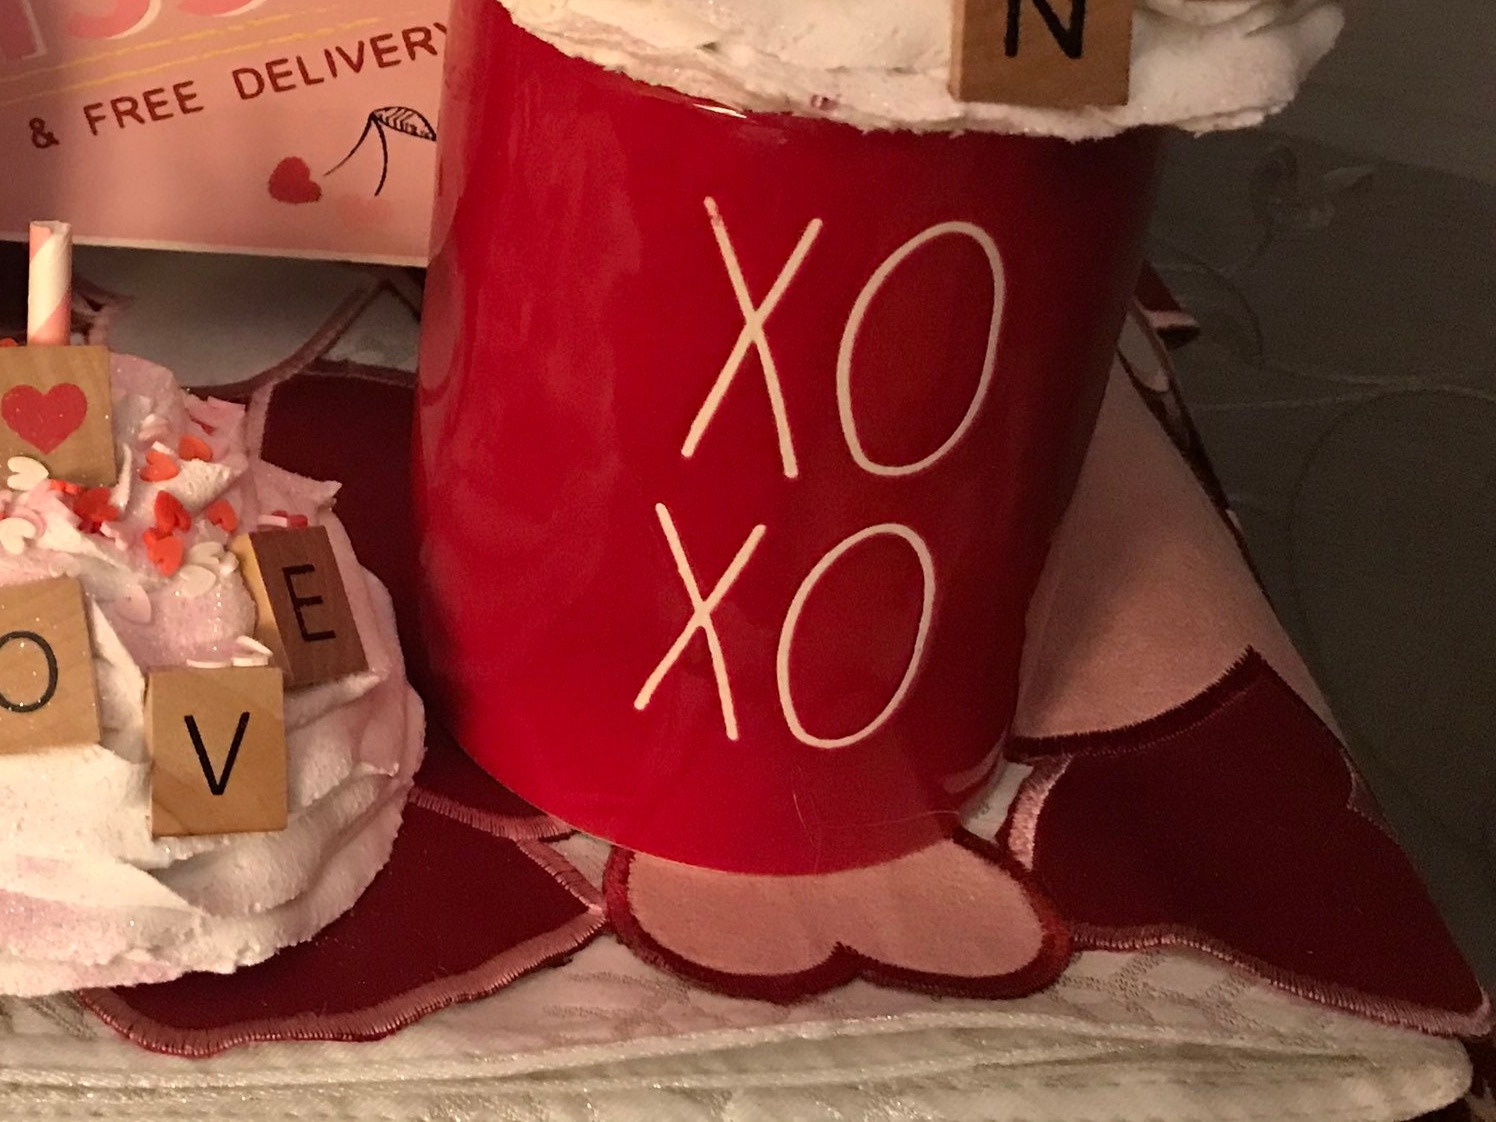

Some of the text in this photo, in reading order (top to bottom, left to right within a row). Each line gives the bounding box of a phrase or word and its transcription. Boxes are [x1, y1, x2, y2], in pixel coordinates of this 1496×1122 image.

[28, 117, 60, 150] &
[83, 81, 205, 137] FREE
[232, 22, 448, 100] DELIVER
[681, 196, 1007, 479] XO
[634, 502, 937, 750] XO
